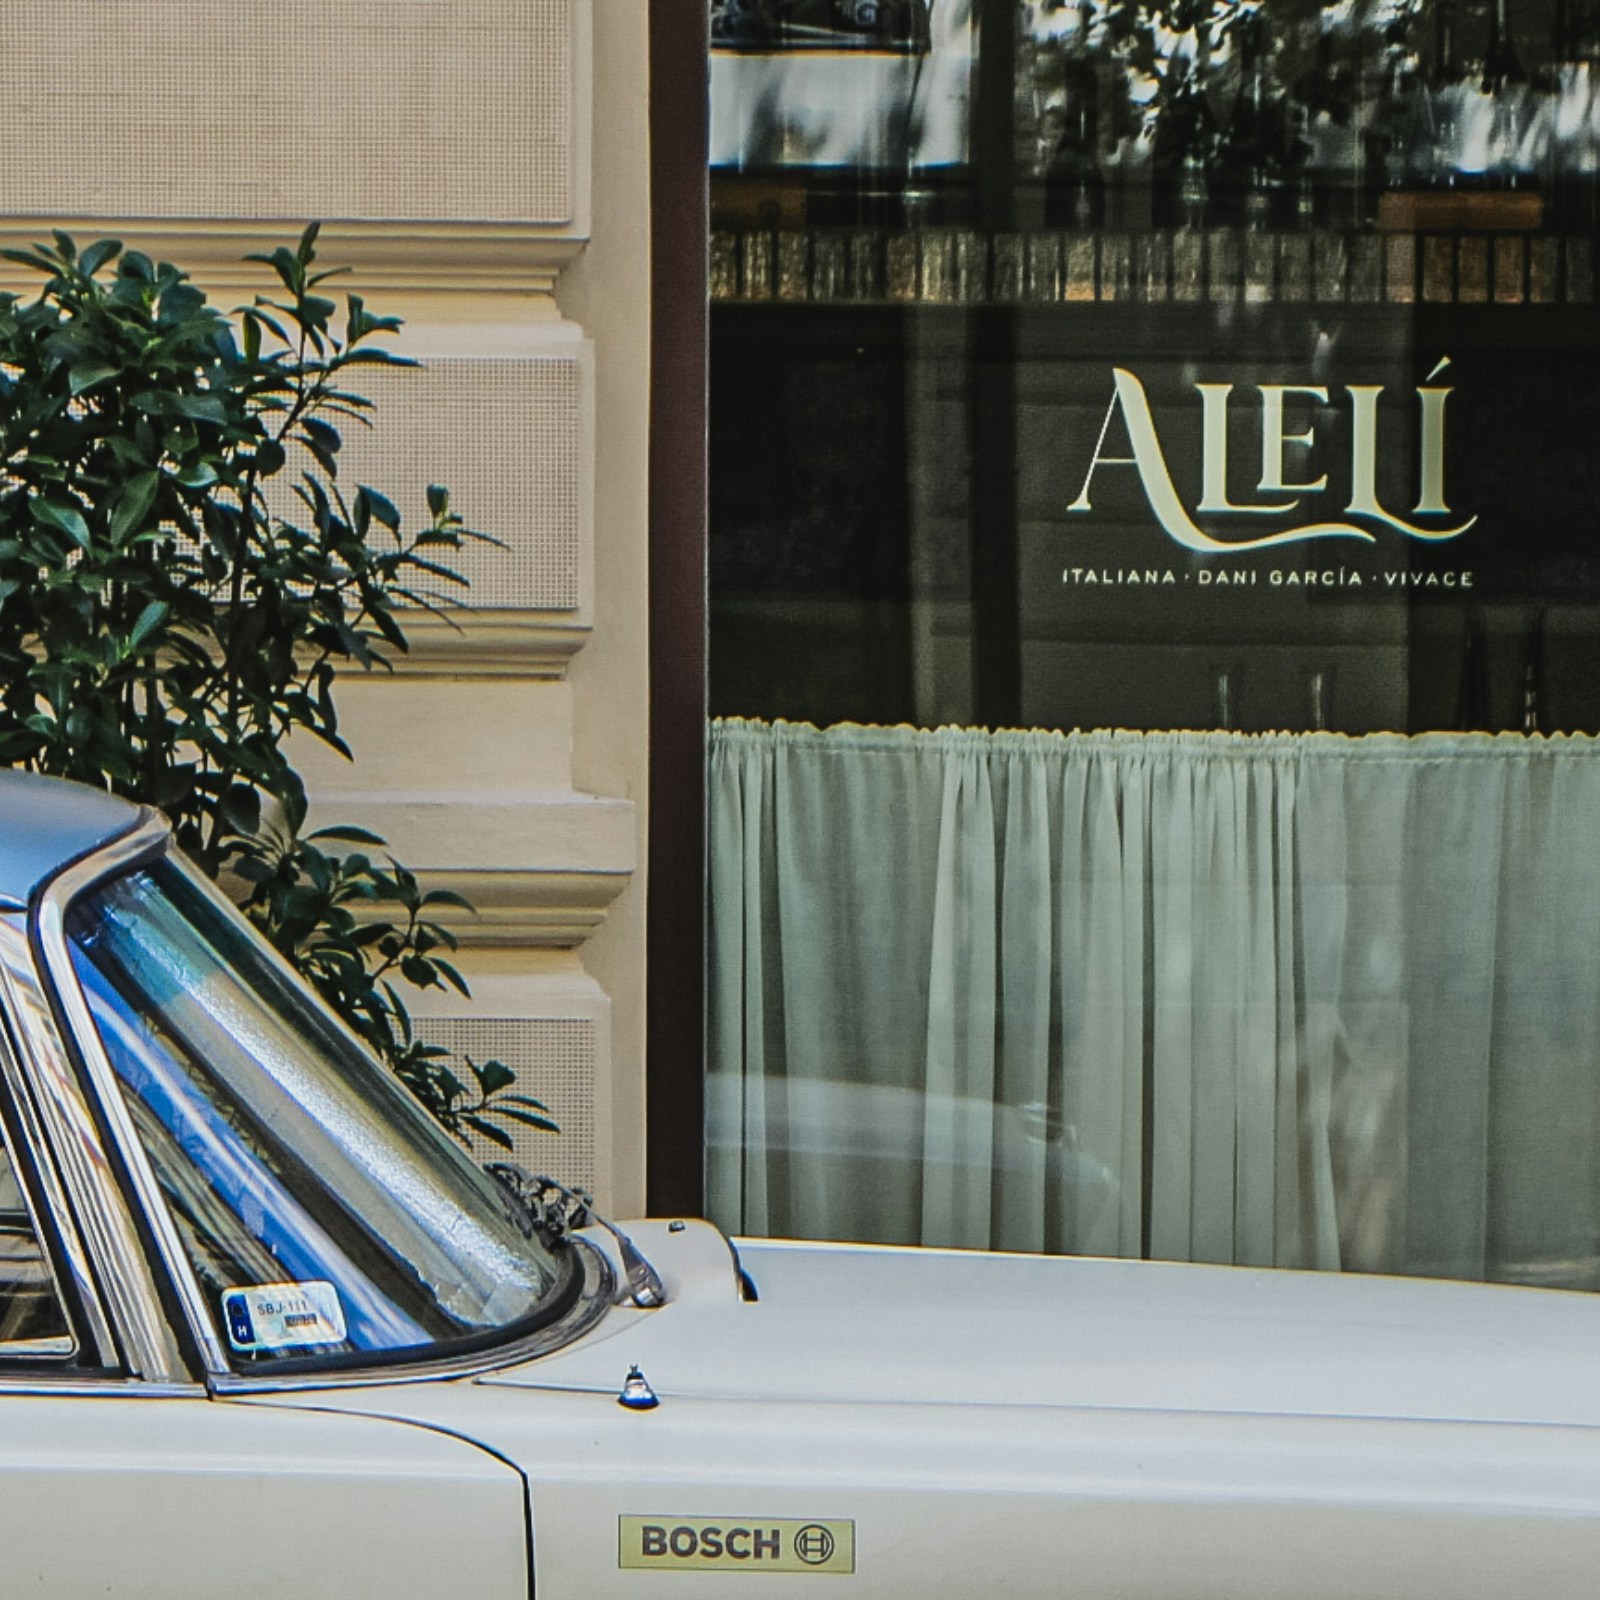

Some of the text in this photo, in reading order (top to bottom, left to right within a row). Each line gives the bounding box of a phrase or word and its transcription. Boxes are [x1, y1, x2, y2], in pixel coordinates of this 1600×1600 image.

[1067, 356, 1478, 552] ALELÍ
[1062, 565, 1474, 587] ITALIANA DANI GARCÍA VIVACE
[237, 1325, 247, 1337] H
[642, 1525, 780, 1559] BOSCH
